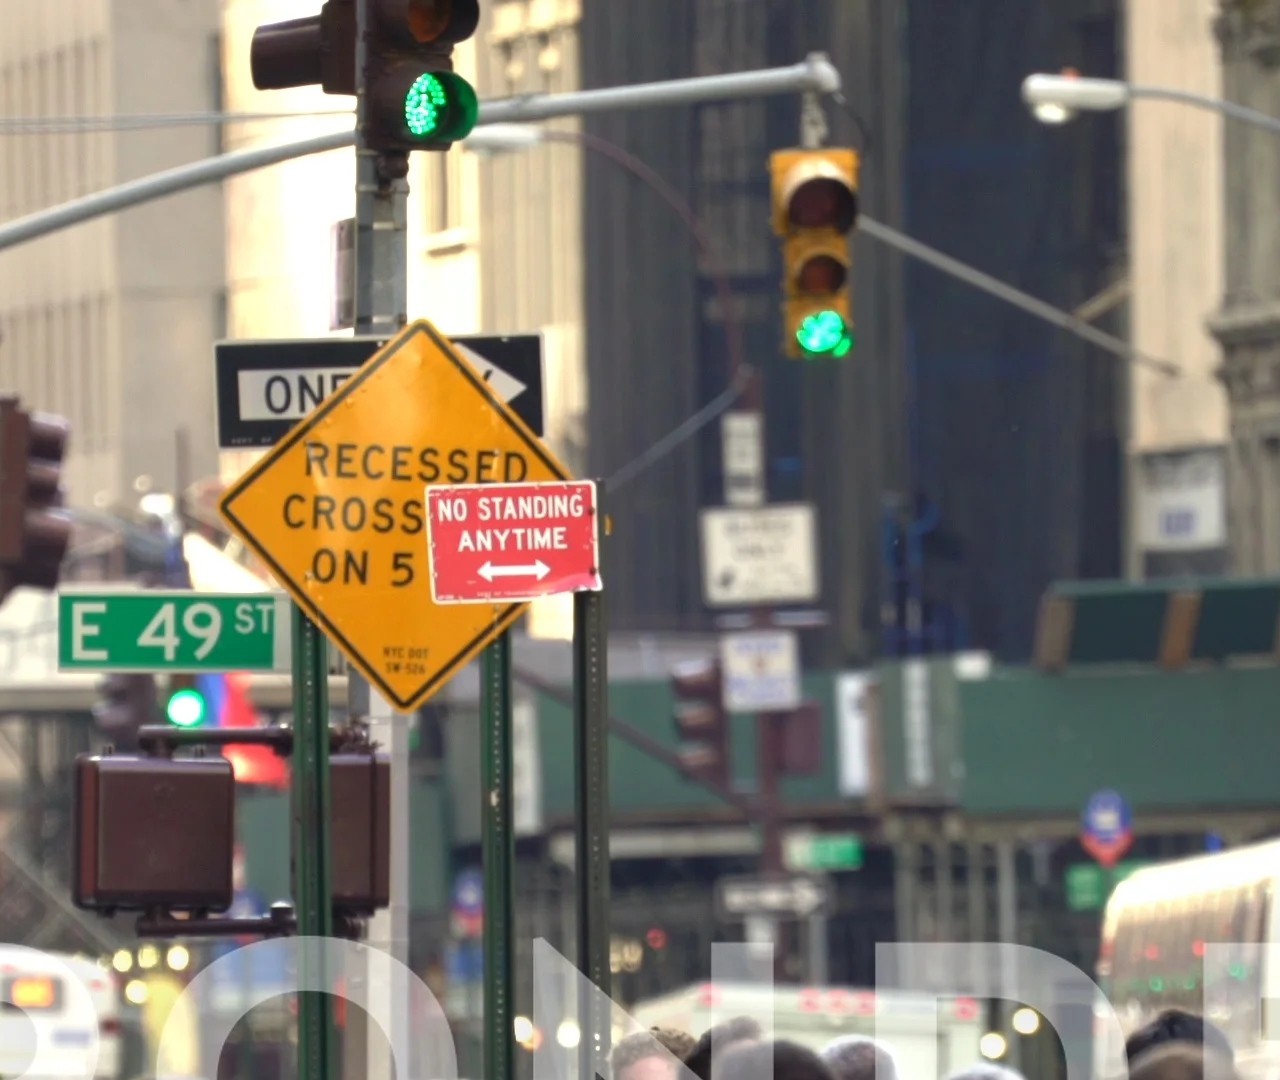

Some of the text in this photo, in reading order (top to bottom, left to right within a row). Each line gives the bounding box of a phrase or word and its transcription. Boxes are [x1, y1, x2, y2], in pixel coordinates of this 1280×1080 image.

[304, 441, 528, 484] RECESSED
[437, 493, 584, 522] NO STANDING
[457, 526, 568, 552] ANYTIME
[311, 548, 415, 587] ON 5
[71, 601, 109, 662] E
[136, 601, 222, 662] 49
[234, 602, 275, 634] ST
